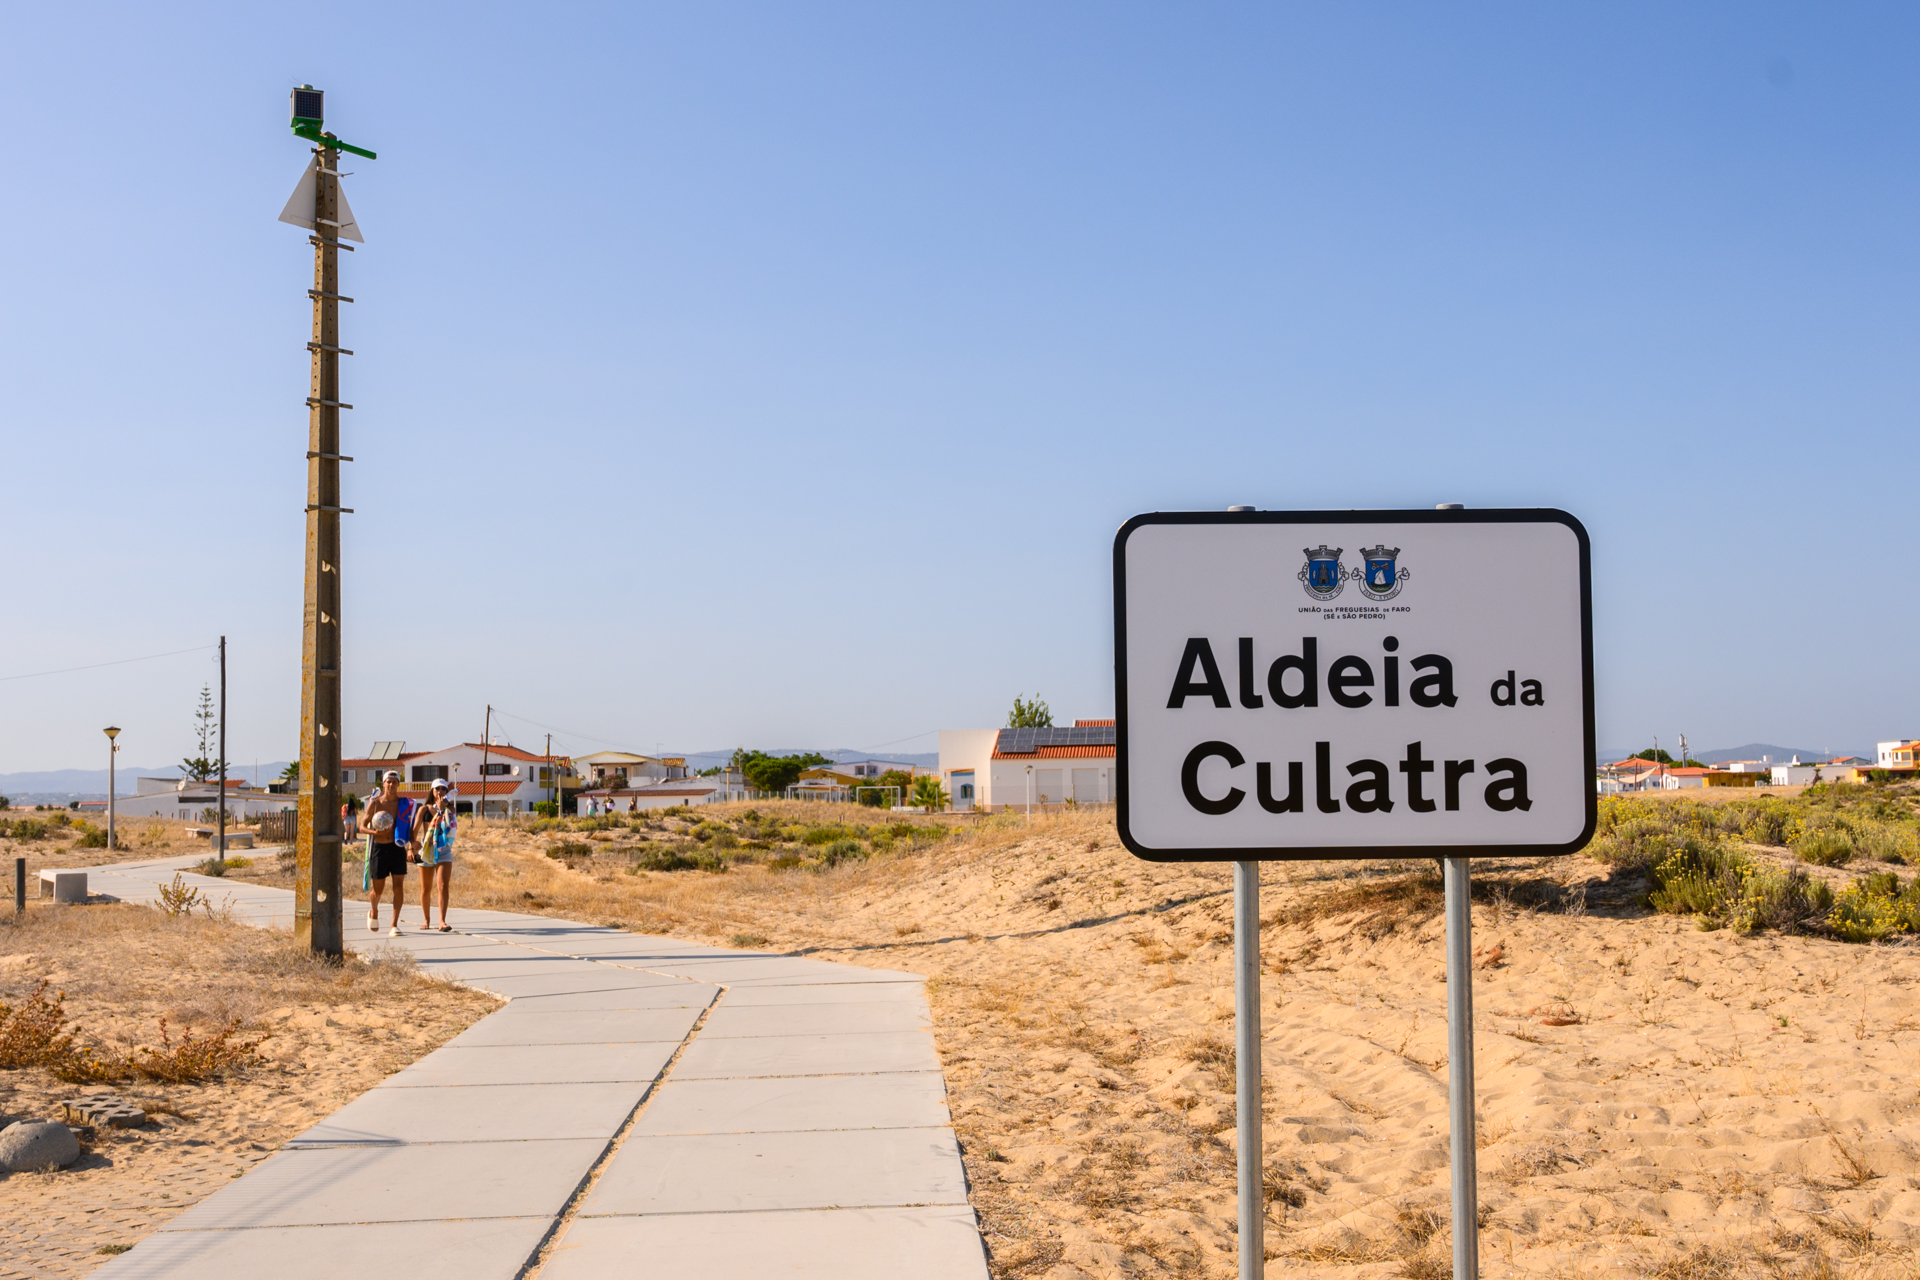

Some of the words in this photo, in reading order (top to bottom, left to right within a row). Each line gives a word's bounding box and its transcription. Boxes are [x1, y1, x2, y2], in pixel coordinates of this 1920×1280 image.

[1298, 605, 1321, 613] UNIÃO
[1342, 612, 1357, 620] SÃO
[1165, 635, 1459, 710] Aldeia
[1490, 669, 1545, 707] da
[1180, 740, 1534, 816] Culatra
